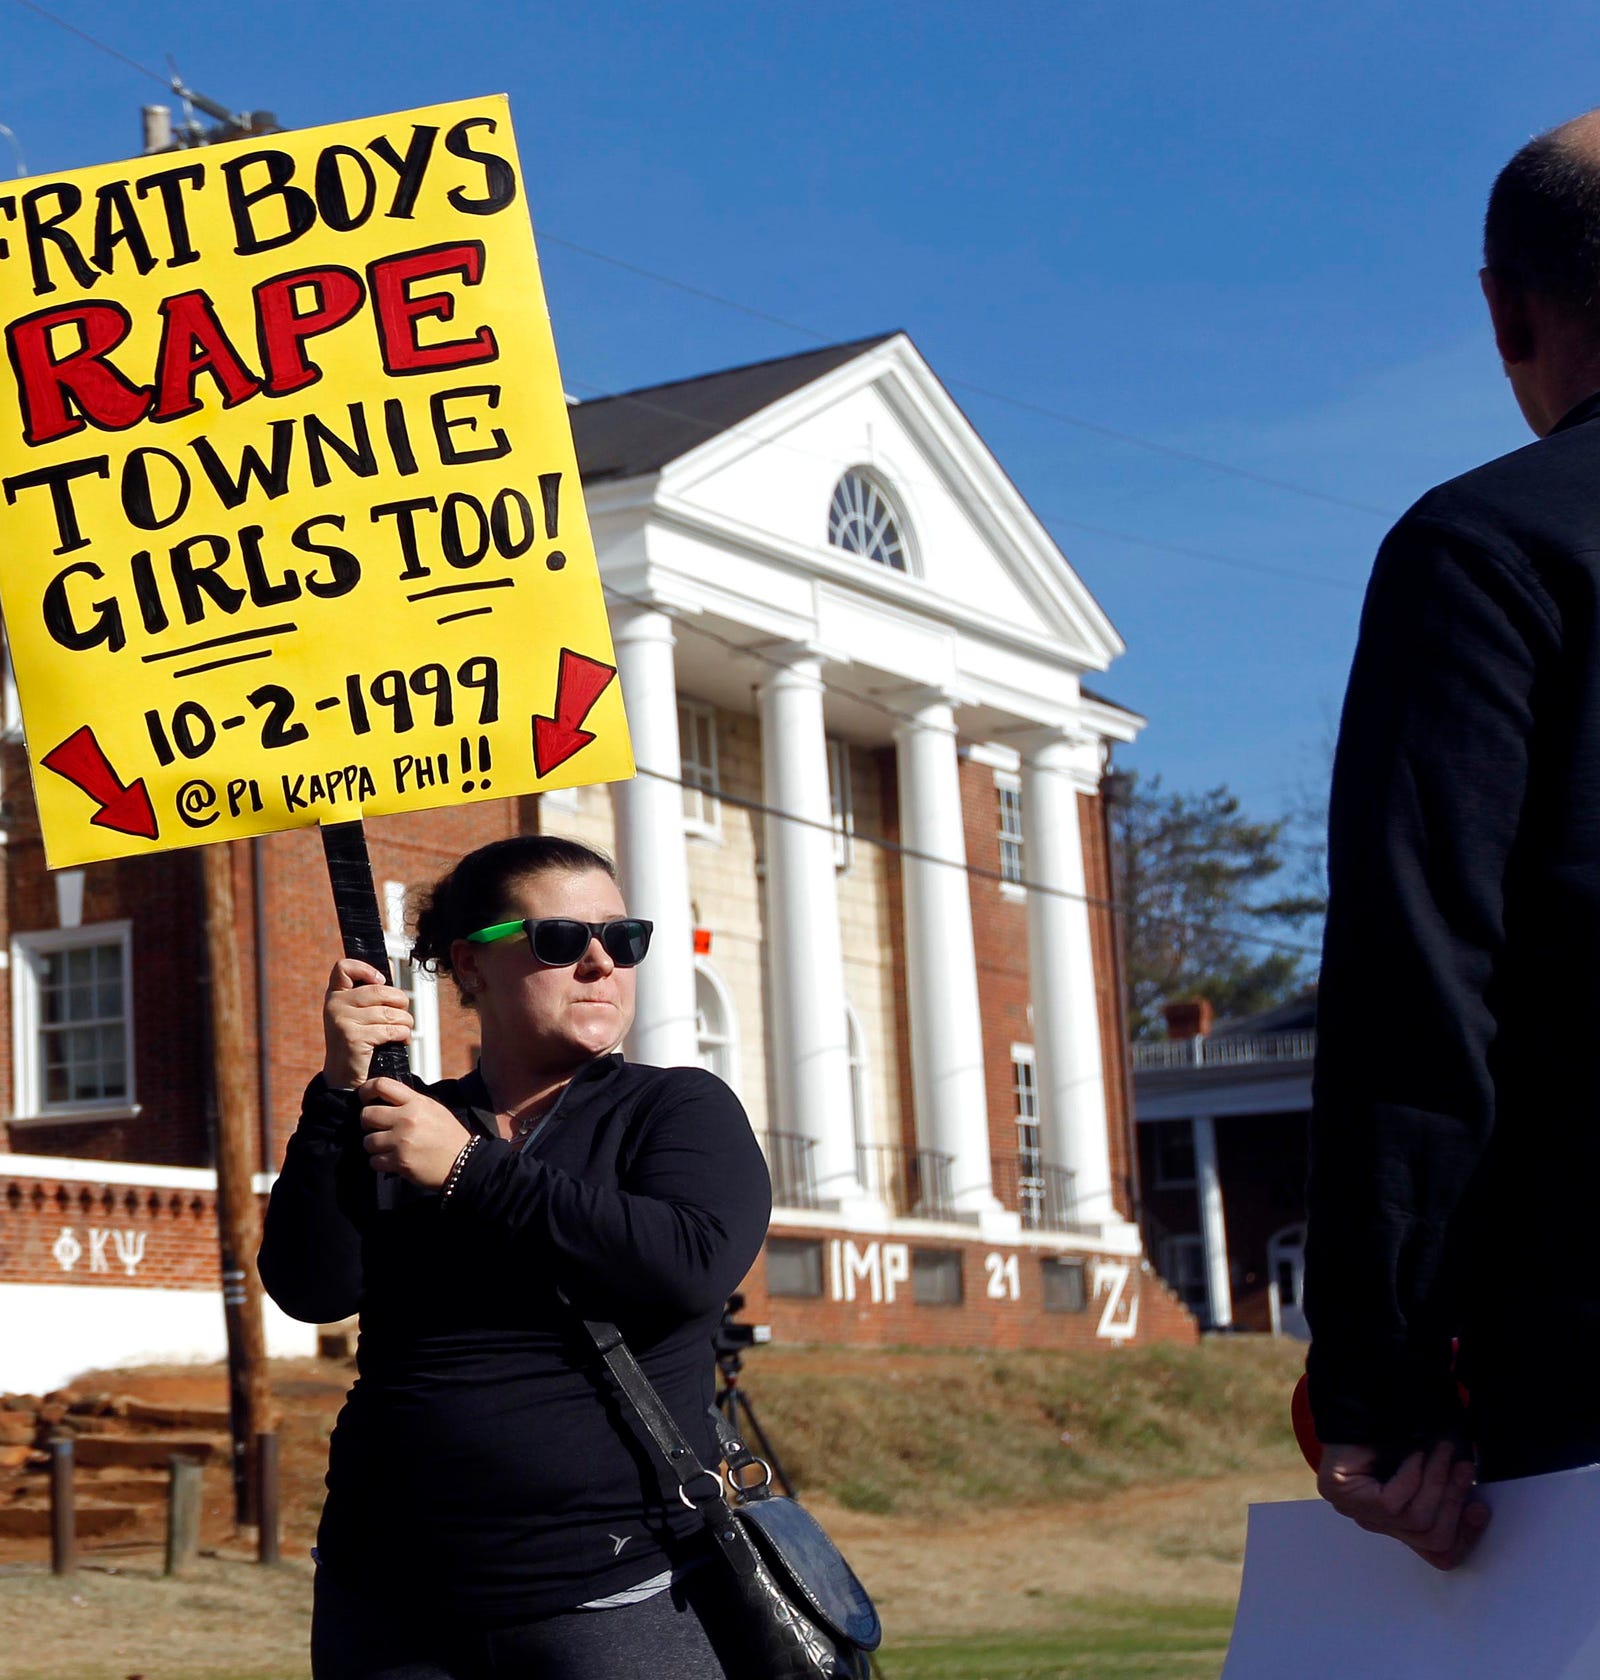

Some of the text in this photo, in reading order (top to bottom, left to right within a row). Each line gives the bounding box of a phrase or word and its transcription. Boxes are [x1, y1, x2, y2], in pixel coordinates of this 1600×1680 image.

[222, 116, 515, 257] BOYS
[4, 240, 500, 447] RAPE
[3, 384, 512, 556] TOWNIE
[40, 471, 564, 653] GIRLS TOO!
[144, 656, 499, 766] 10-2-1999
[282, 764, 376, 813] KAPPA
[393, 735, 492, 793] PHI!!
[830, 1238, 909, 1304] IMP
[984, 1251, 1021, 1301] 21
